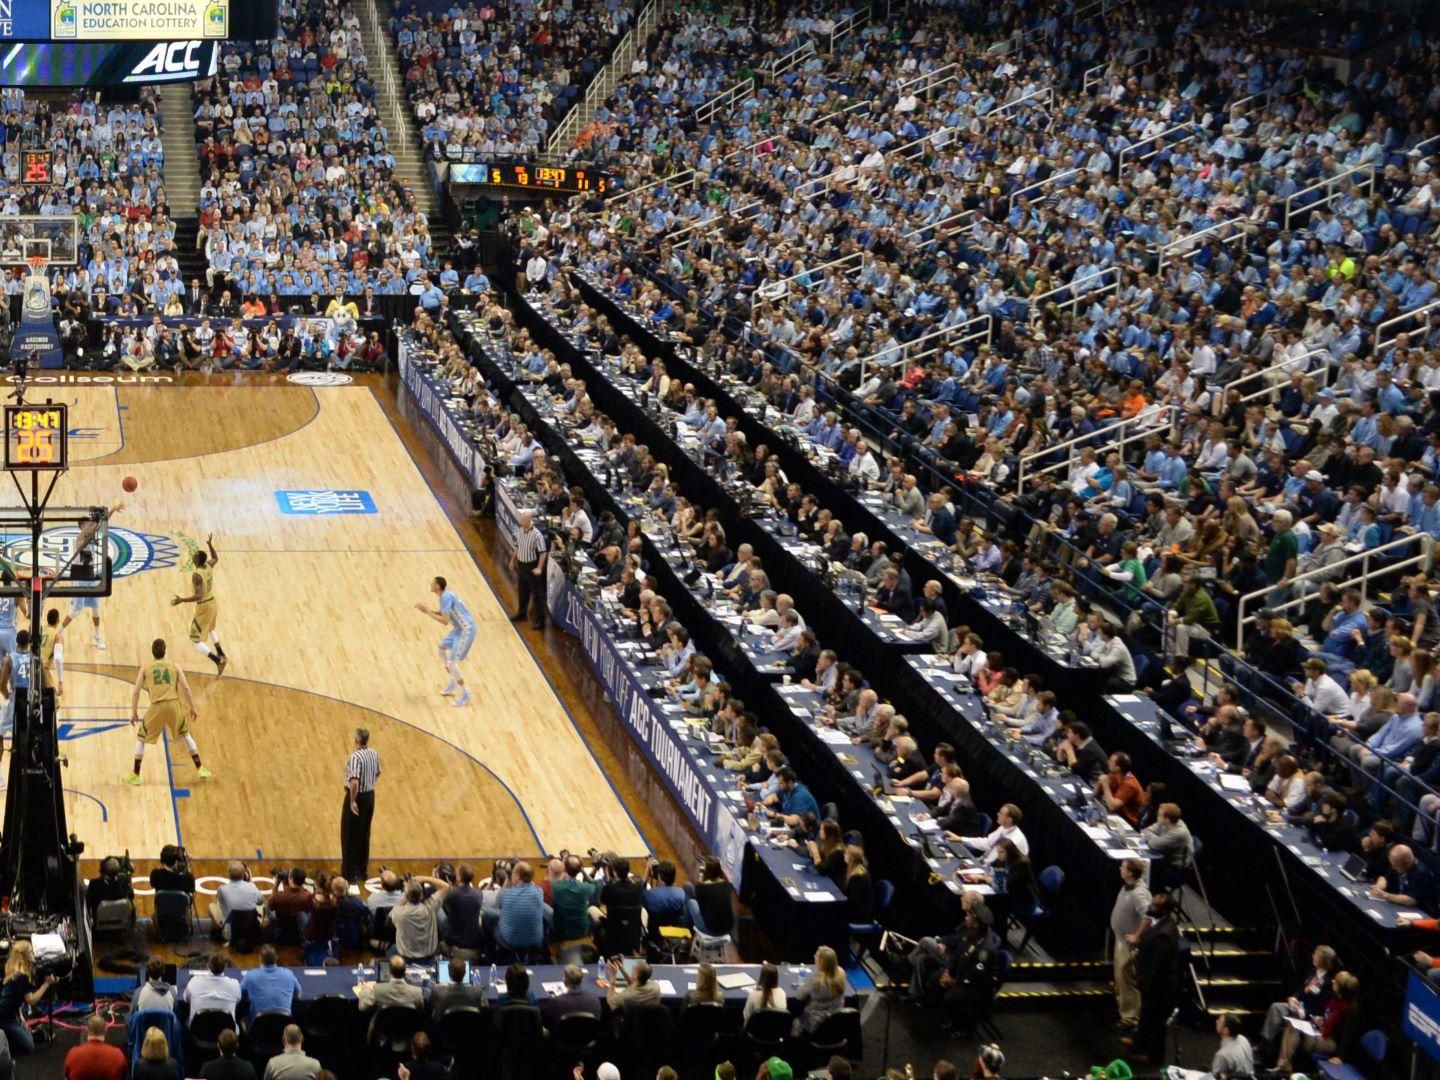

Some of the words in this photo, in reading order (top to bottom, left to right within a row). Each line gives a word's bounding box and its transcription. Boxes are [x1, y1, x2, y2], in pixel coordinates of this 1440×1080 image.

[83, 3, 127, 16] NORTH
[132, 3, 197, 16] CAROLINA
[83, 19, 147, 28] EDUCATION
[151, 18, 197, 28] LOTTERY
[131, 41, 202, 75] ACC
[518, 173, 528, 185] 13
[539, 168, 565, 180] 13:47
[578, 179, 589, 189] 11
[5, 374, 172, 383] Coliseum
[16, 411, 59, 429] 13:47
[17, 431, 53, 462] 25
[334, 493, 365, 510] LIFE
[152, 667, 171, 684] 24
[583, 612, 598, 663] NEW
[615, 665, 631, 718] LIFE
[629, 690, 649, 742] ACC
[651, 714, 712, 833] TOURNAMENT
